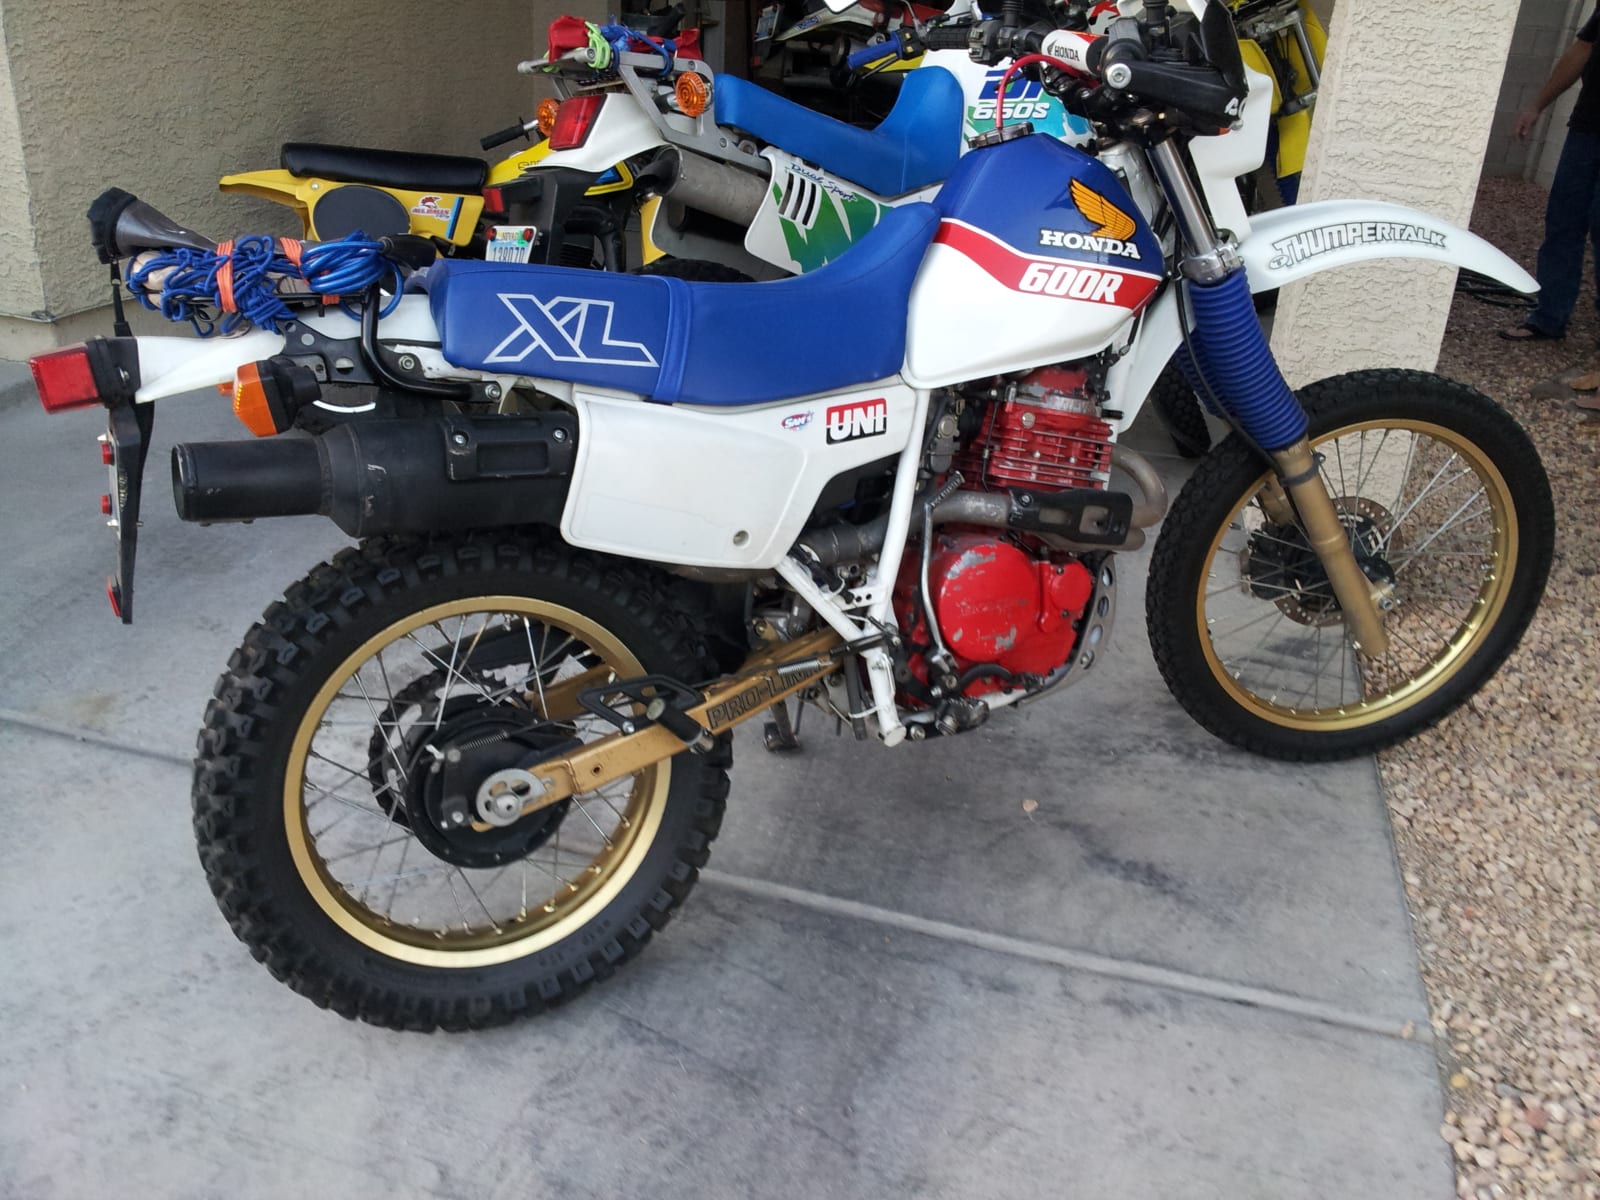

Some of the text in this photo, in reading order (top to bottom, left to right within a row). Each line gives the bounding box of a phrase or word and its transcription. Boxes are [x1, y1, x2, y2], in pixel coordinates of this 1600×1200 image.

[1054, 45, 1080, 62] HONDA
[790, 162, 857, 201] Dual Sport
[1039, 229, 1141, 260] HONDA
[1271, 221, 1447, 266] THUMPERTALK
[1018, 262, 1124, 303] 600R
[482, 293, 660, 368] XL
[829, 404, 885, 441] UNI
